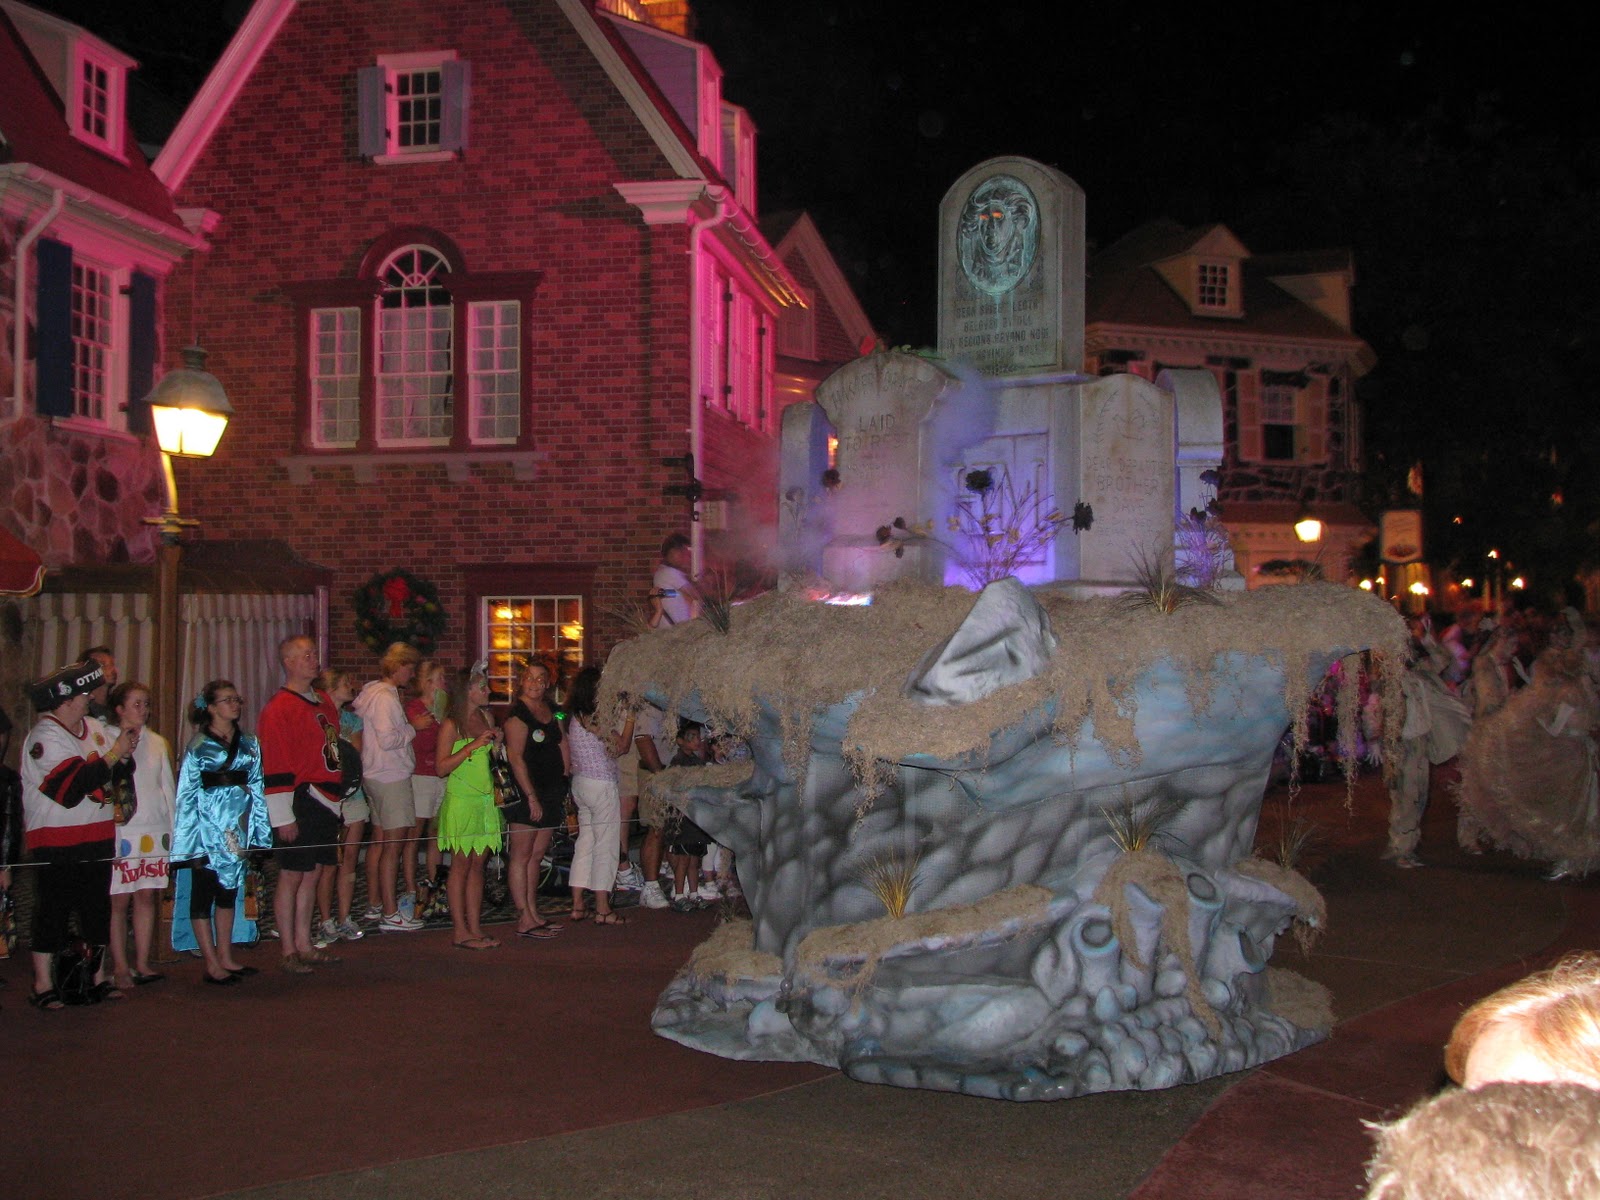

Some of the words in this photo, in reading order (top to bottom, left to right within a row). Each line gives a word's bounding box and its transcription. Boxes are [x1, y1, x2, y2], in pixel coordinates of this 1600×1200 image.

[858, 413, 896, 433] LAID
[843, 434, 862, 451] TO
[1096, 474, 1160, 497] BROTHER
